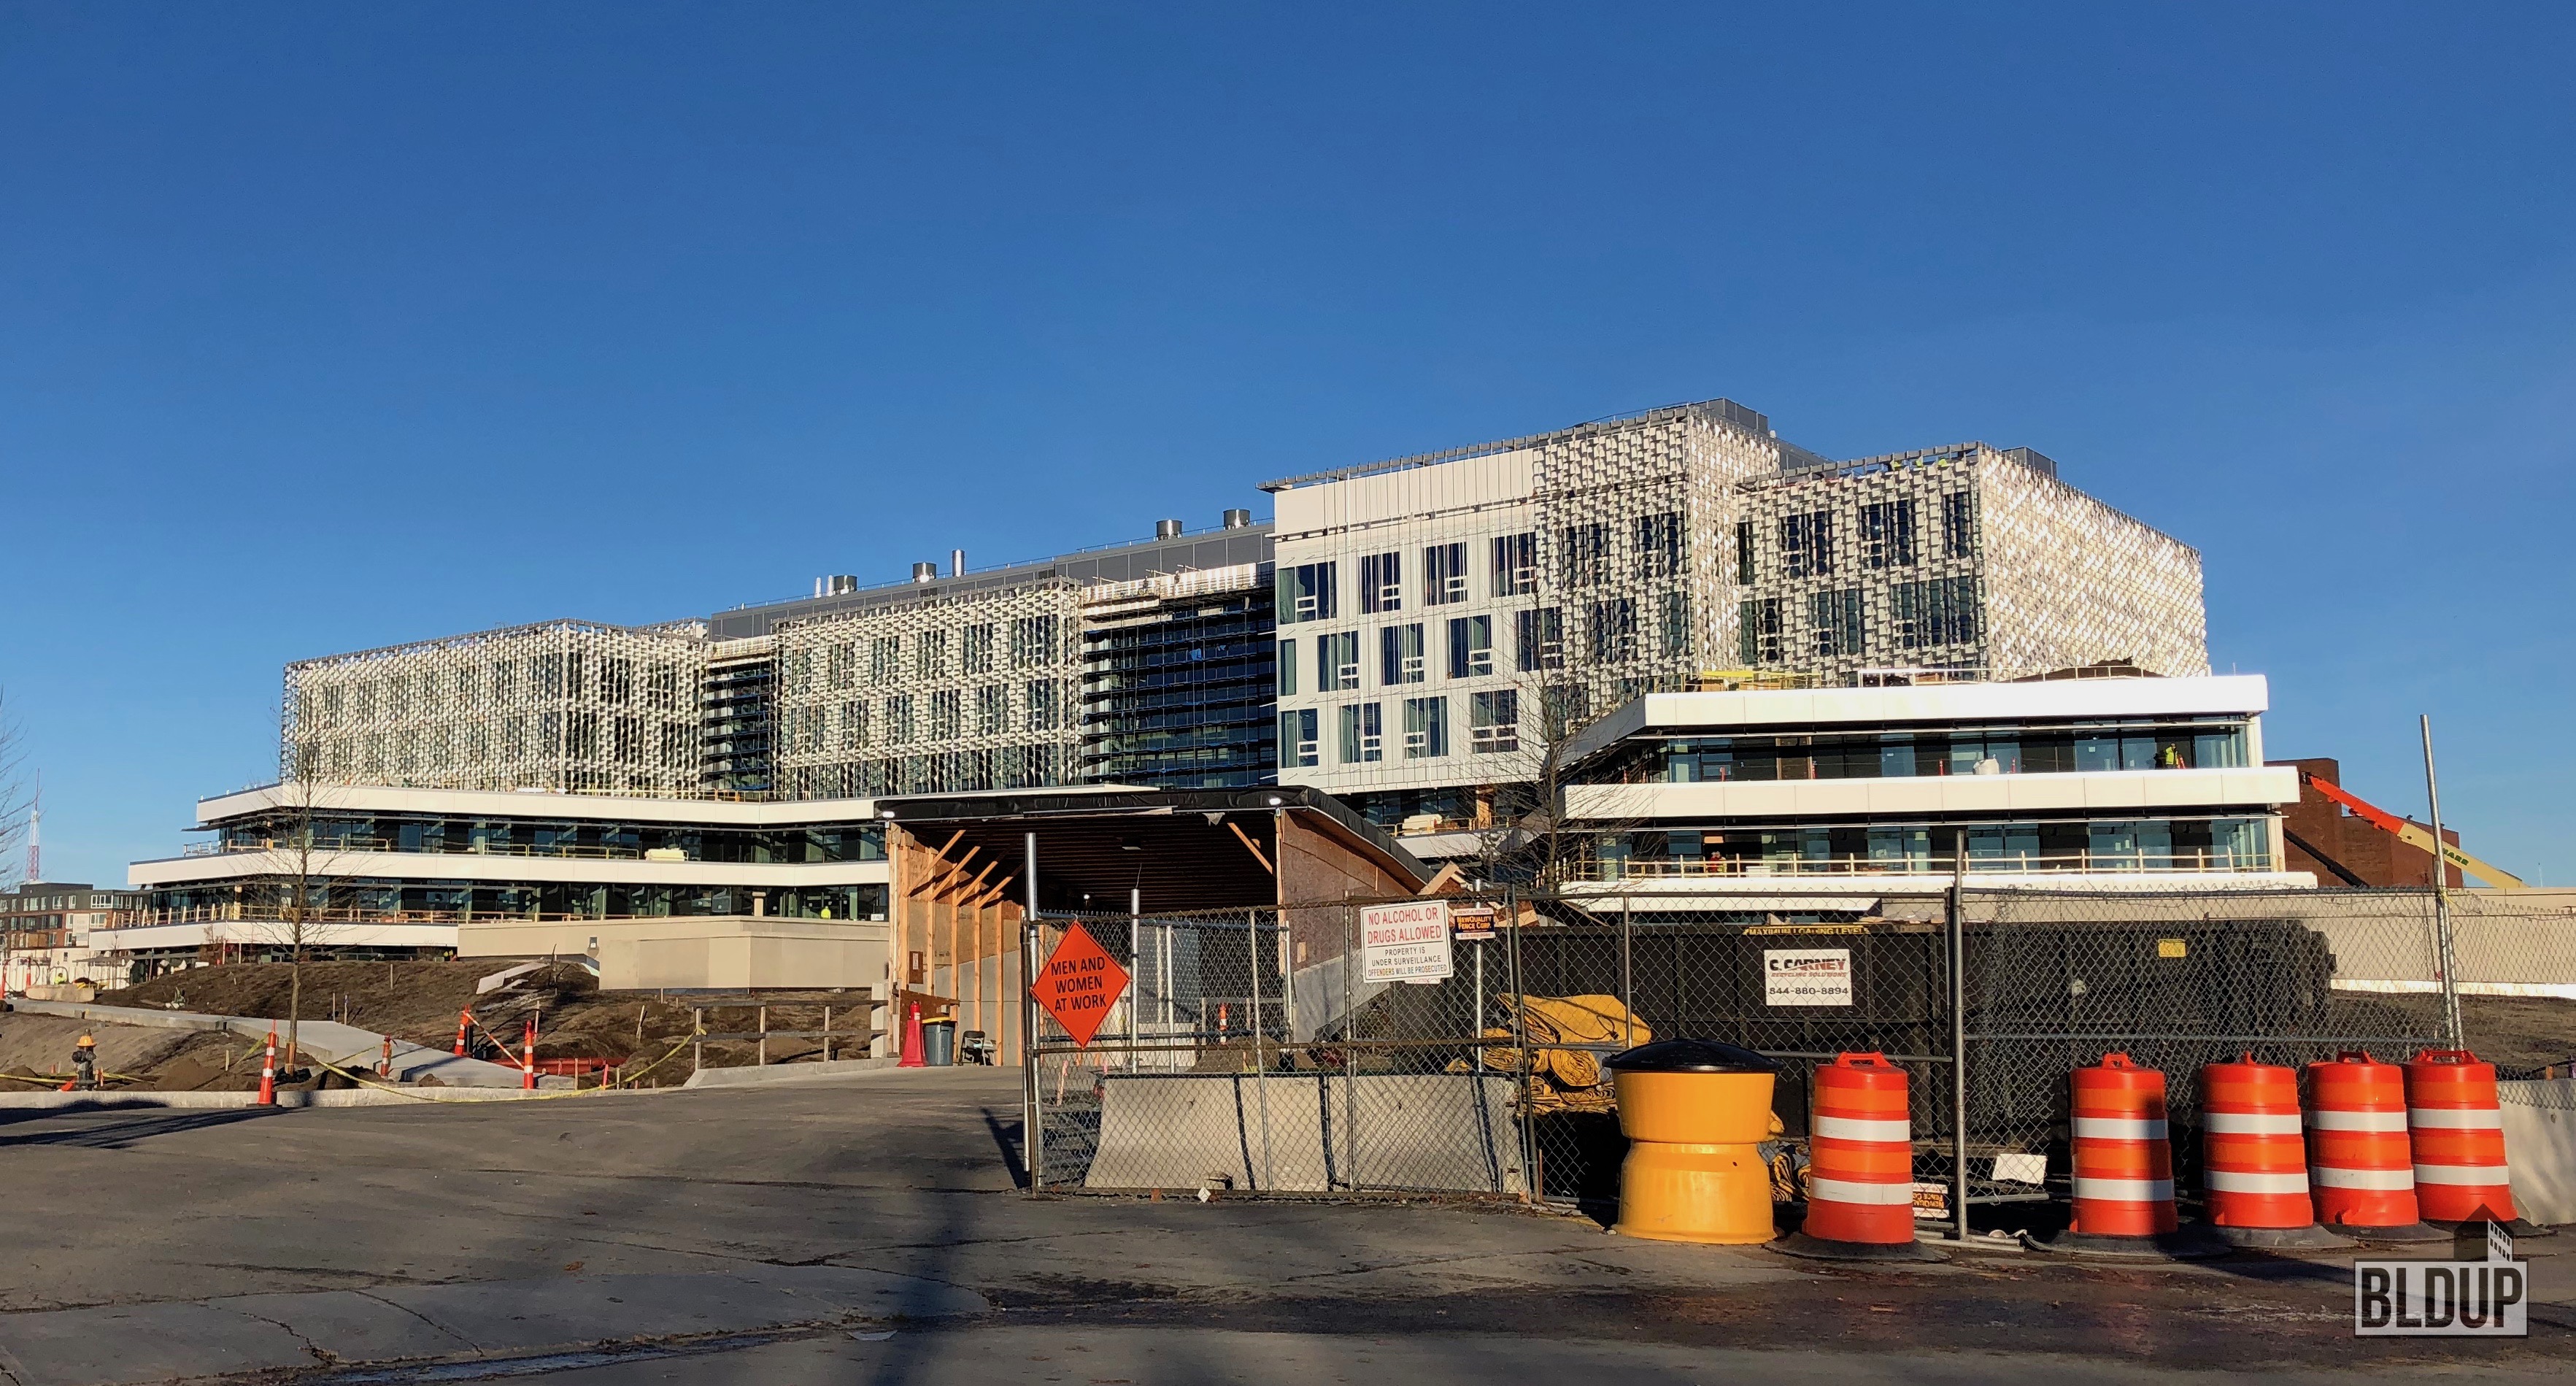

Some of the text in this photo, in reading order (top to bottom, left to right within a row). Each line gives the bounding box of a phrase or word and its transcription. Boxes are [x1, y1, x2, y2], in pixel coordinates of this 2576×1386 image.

[1368, 907, 1438, 925] NO ALCOHOL OR
[1368, 925, 1441, 944] DRUGS ALLOWED
[1384, 946, 1425, 956] PROPERTY IS
[1051, 956, 1106, 976] MEN AND
[1372, 955, 1441, 966] UNDER SURVEILLANCE
[1783, 958, 1846, 971] CARNEY
[1368, 964, 1447, 977] OFFENDERS WILL BE PROSECUTED
[1055, 975, 1103, 994] WOMEN
[1769, 987, 1849, 995] 844-880-8894
[1054, 993, 1106, 1012] AT WORK
